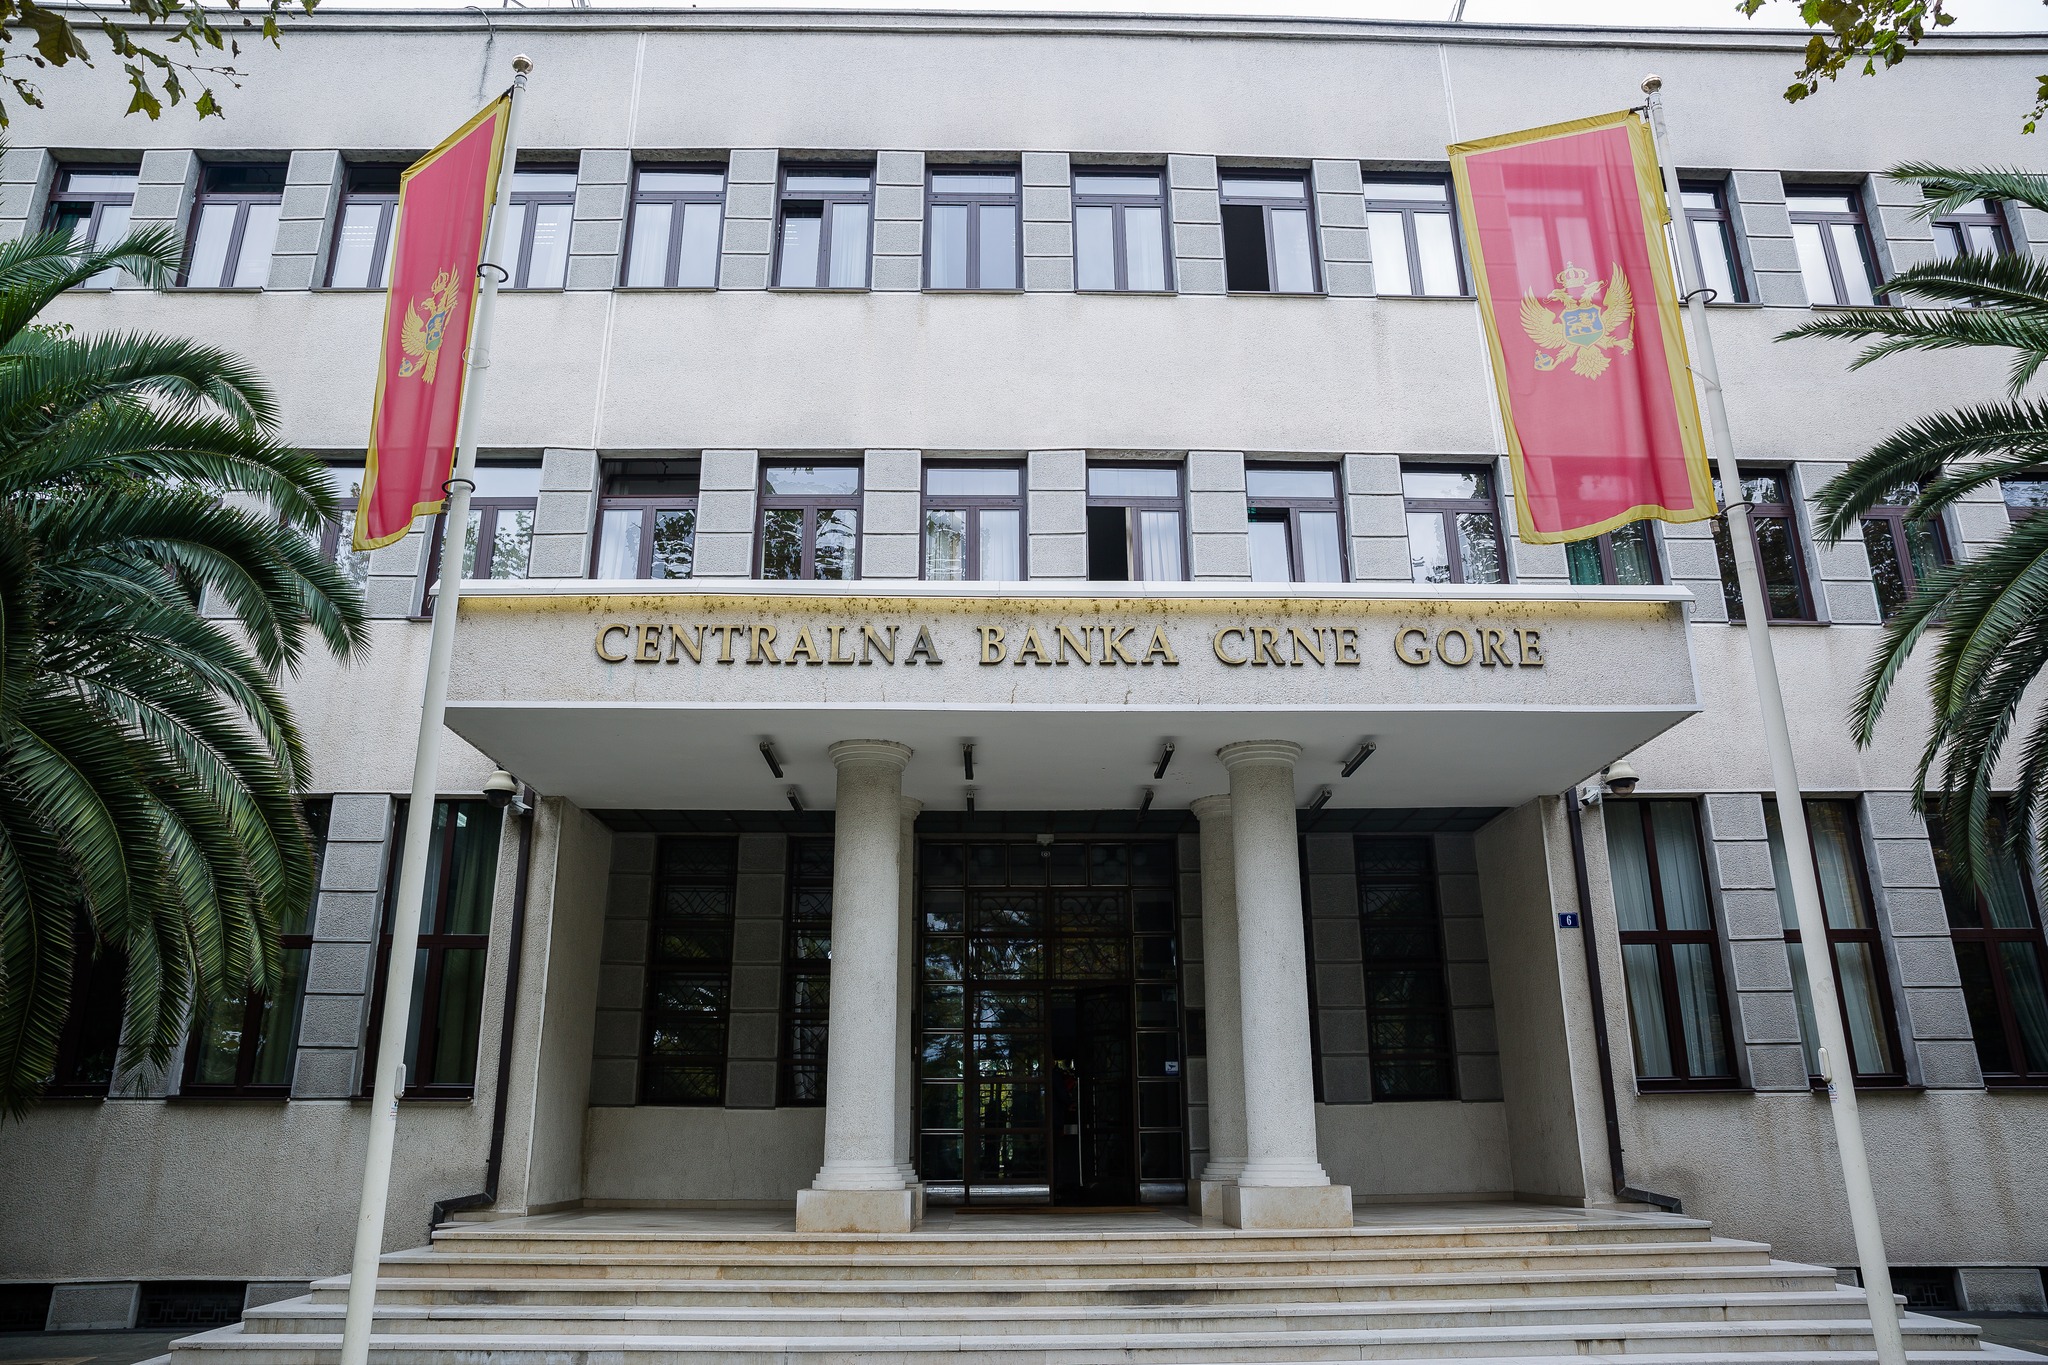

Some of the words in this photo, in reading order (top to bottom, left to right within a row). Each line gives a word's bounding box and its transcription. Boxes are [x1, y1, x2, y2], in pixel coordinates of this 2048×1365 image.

[595, 624, 944, 665] CENTRALNA
[977, 625, 1180, 665] BANKA
[1213, 626, 1361, 666] CRNE
[1394, 627, 1545, 667] GORE
[1566, 914, 1572, 926] 6
